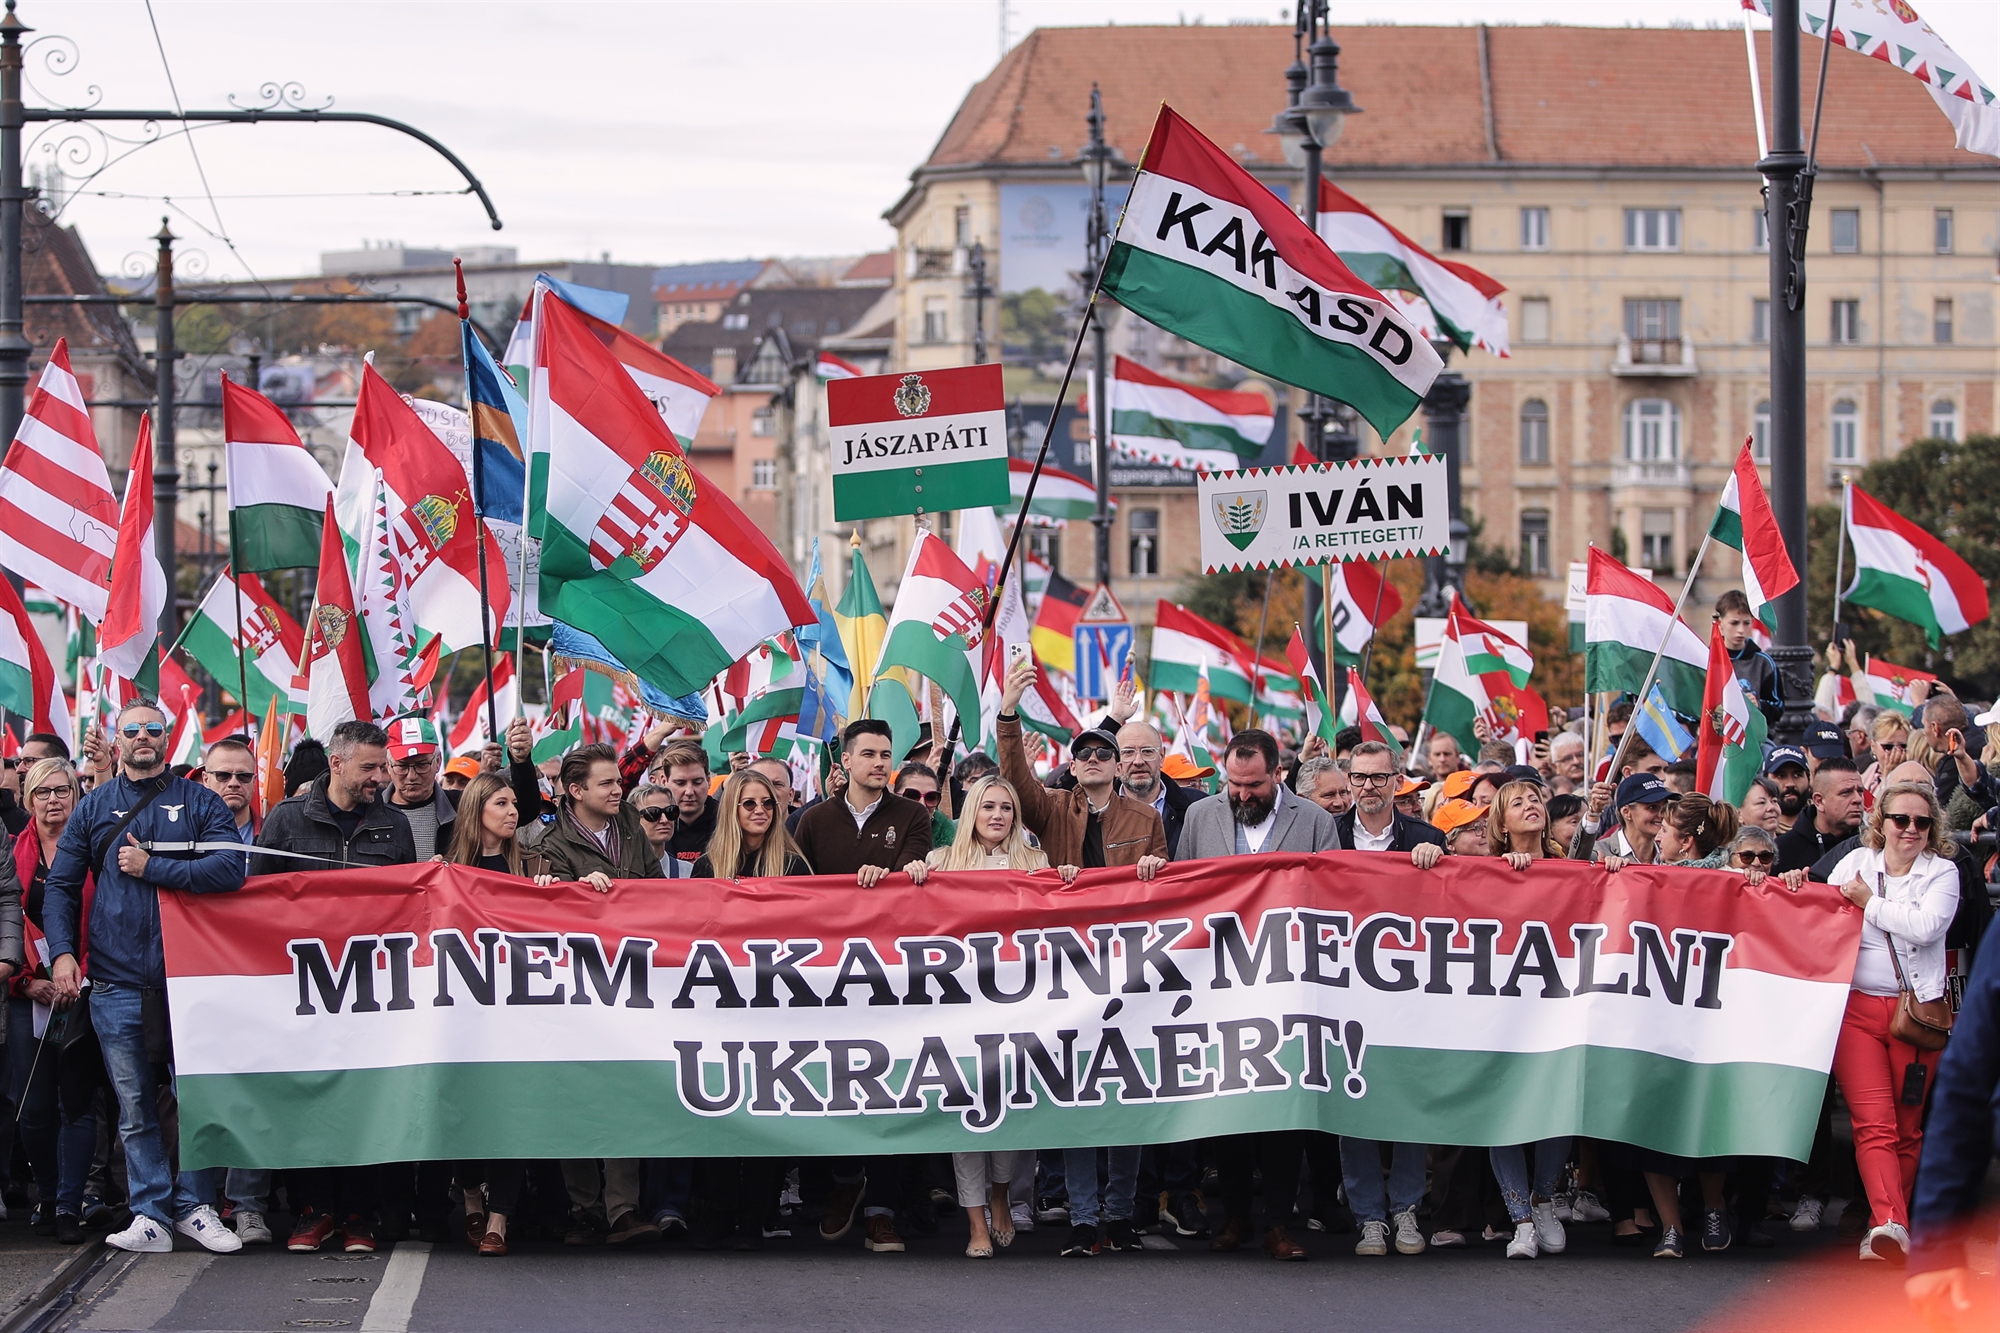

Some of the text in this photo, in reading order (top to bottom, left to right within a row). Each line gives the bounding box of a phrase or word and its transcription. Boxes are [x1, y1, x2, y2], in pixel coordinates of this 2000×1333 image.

[843, 424, 988, 465] JÁSZAPÁTI
[1288, 478, 1423, 528] IVÁN
[1293, 525, 1424, 549] /A RETTEGETT/
[290, 911, 1732, 1016] MI NEM AKARUNK MEGHALNI
[672, 994, 1366, 1129] UKRAJNÁÉRT!
